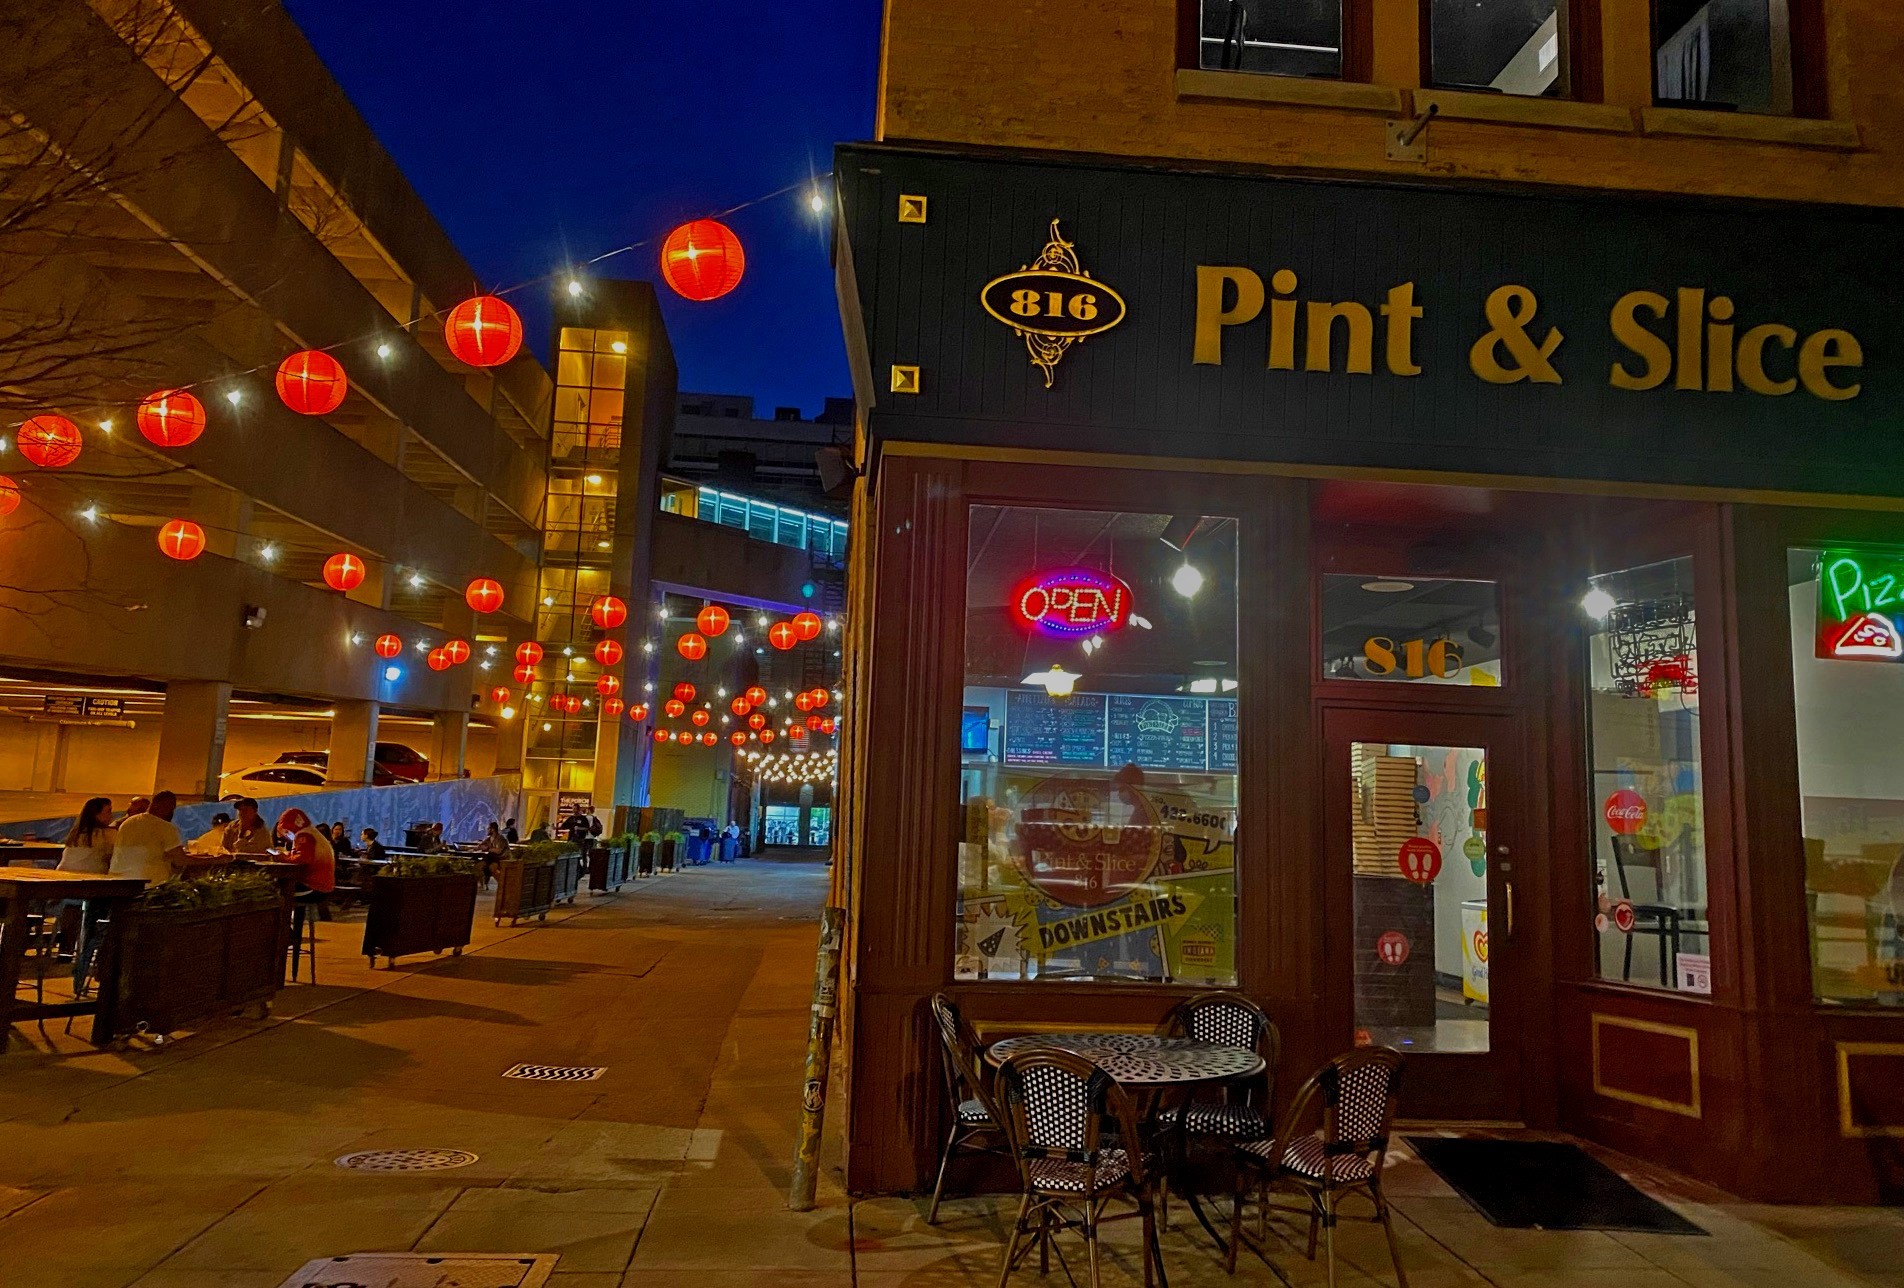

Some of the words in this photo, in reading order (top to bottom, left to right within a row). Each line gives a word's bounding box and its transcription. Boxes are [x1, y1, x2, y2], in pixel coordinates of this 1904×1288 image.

[1008, 288, 1099, 322] 816
[1193, 265, 1424, 377] Pint
[1469, 284, 1564, 385] &
[1610, 287, 1864, 401] Slice
[1020, 587, 1121, 622] OPEN
[1829, 558, 1904, 622] Piz
[1363, 636, 1463, 679] 816
[1076, 852, 1092, 870] &
[1095, 852, 1137, 871] Slice
[1038, 895, 1187, 949] DOWNSTAIRS
